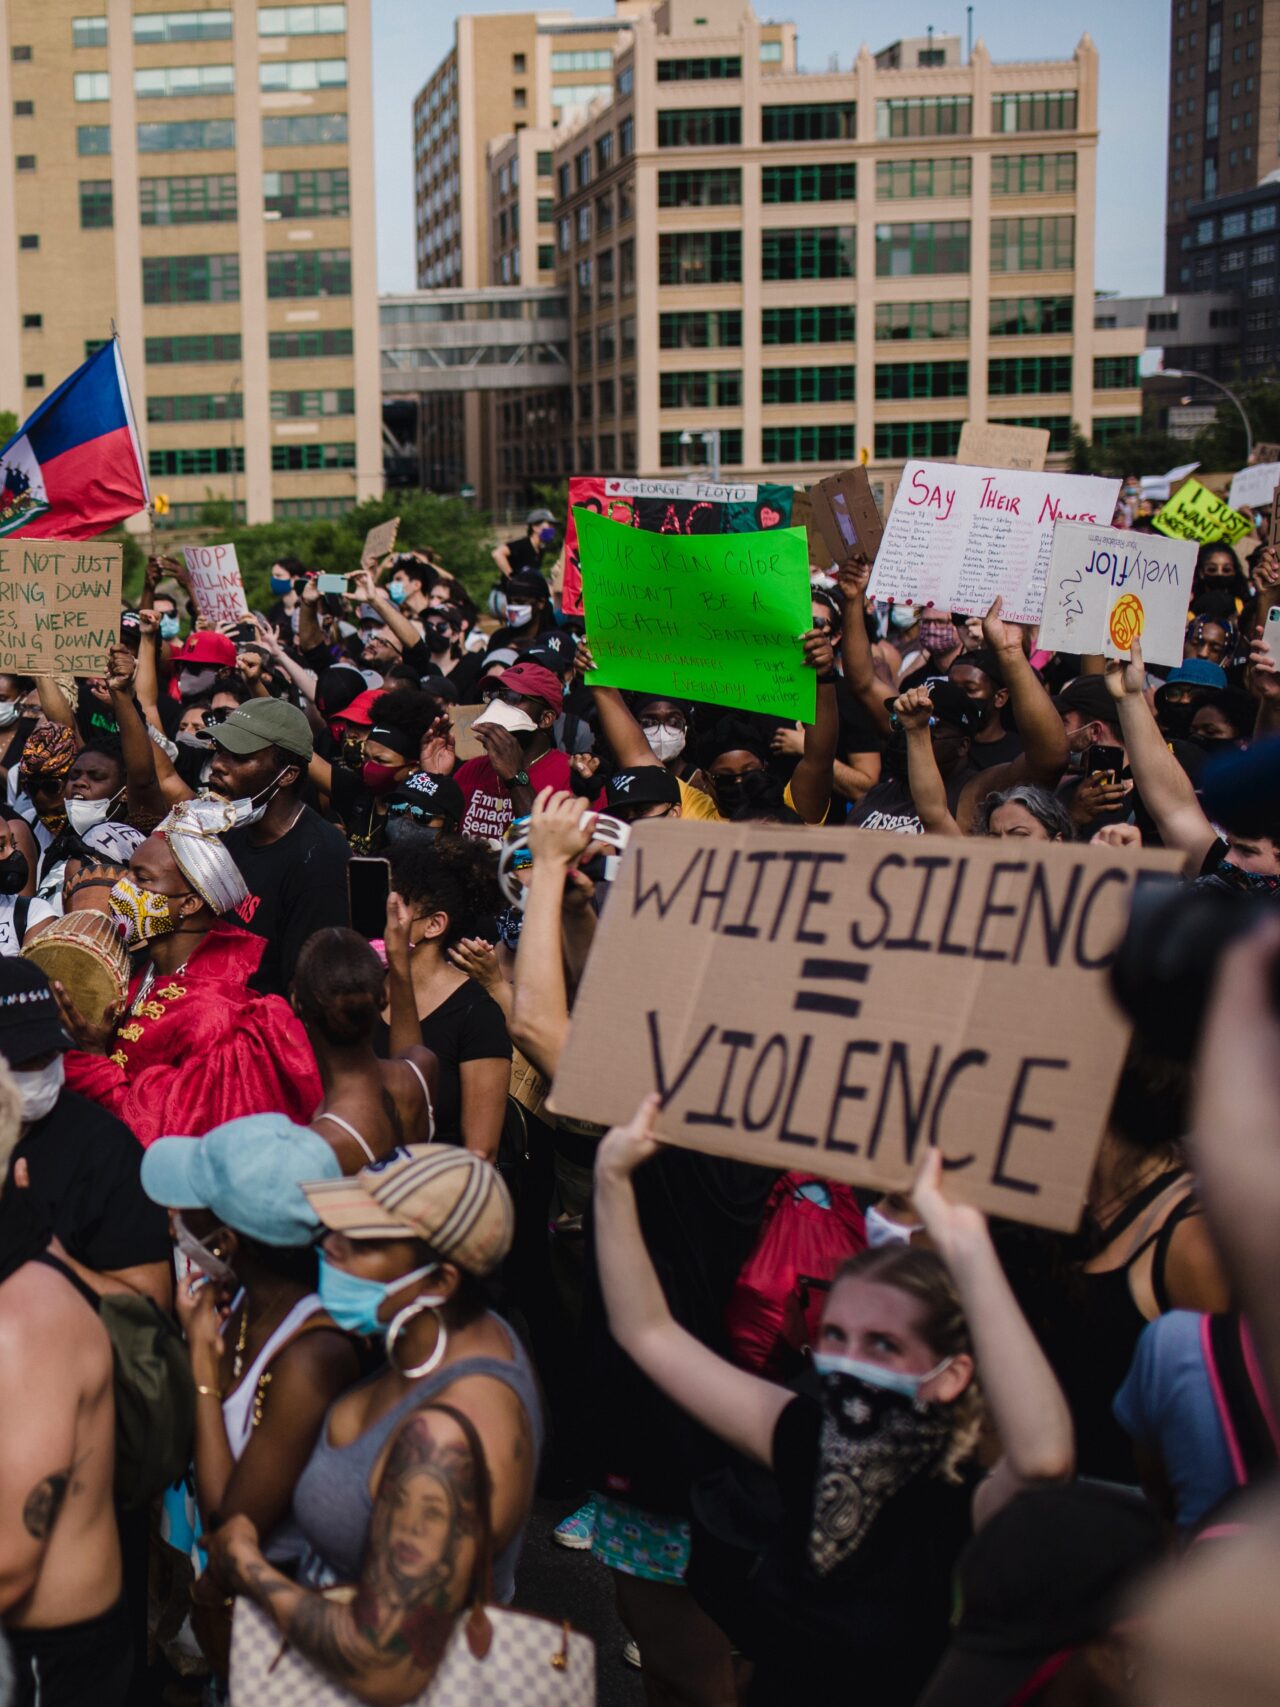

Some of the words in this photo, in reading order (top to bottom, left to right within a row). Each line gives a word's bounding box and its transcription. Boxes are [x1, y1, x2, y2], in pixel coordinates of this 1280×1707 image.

[623, 483, 683, 497] GEORGE
[696, 485, 747, 501] FLOYD
[979, 477, 1021, 516] THEIR
[1177, 503, 1219, 537] WANT
[1206, 501, 1251, 537] JUST
[23, 551, 65, 576] NOT
[71, 554, 119, 574] JUST
[184, 546, 227, 570] STOP
[650, 542, 713, 574] SKIN
[1085, 550, 1180, 590] welyflor
[56, 579, 112, 602] DOWN
[191, 570, 244, 591] KILLING
[197, 590, 242, 610] BLACK
[700, 590, 736, 612] BE
[752, 591, 770, 613] A
[34, 611, 88, 632] WE'RE
[596, 605, 680, 638] DEATH
[54, 630, 104, 650] DOWN
[105, 629, 117, 649] A
[632, 847, 846, 944] WHITE
[849, 852, 1172, 970] SILENC
[647, 1009, 1070, 1195] VIOLENCE
